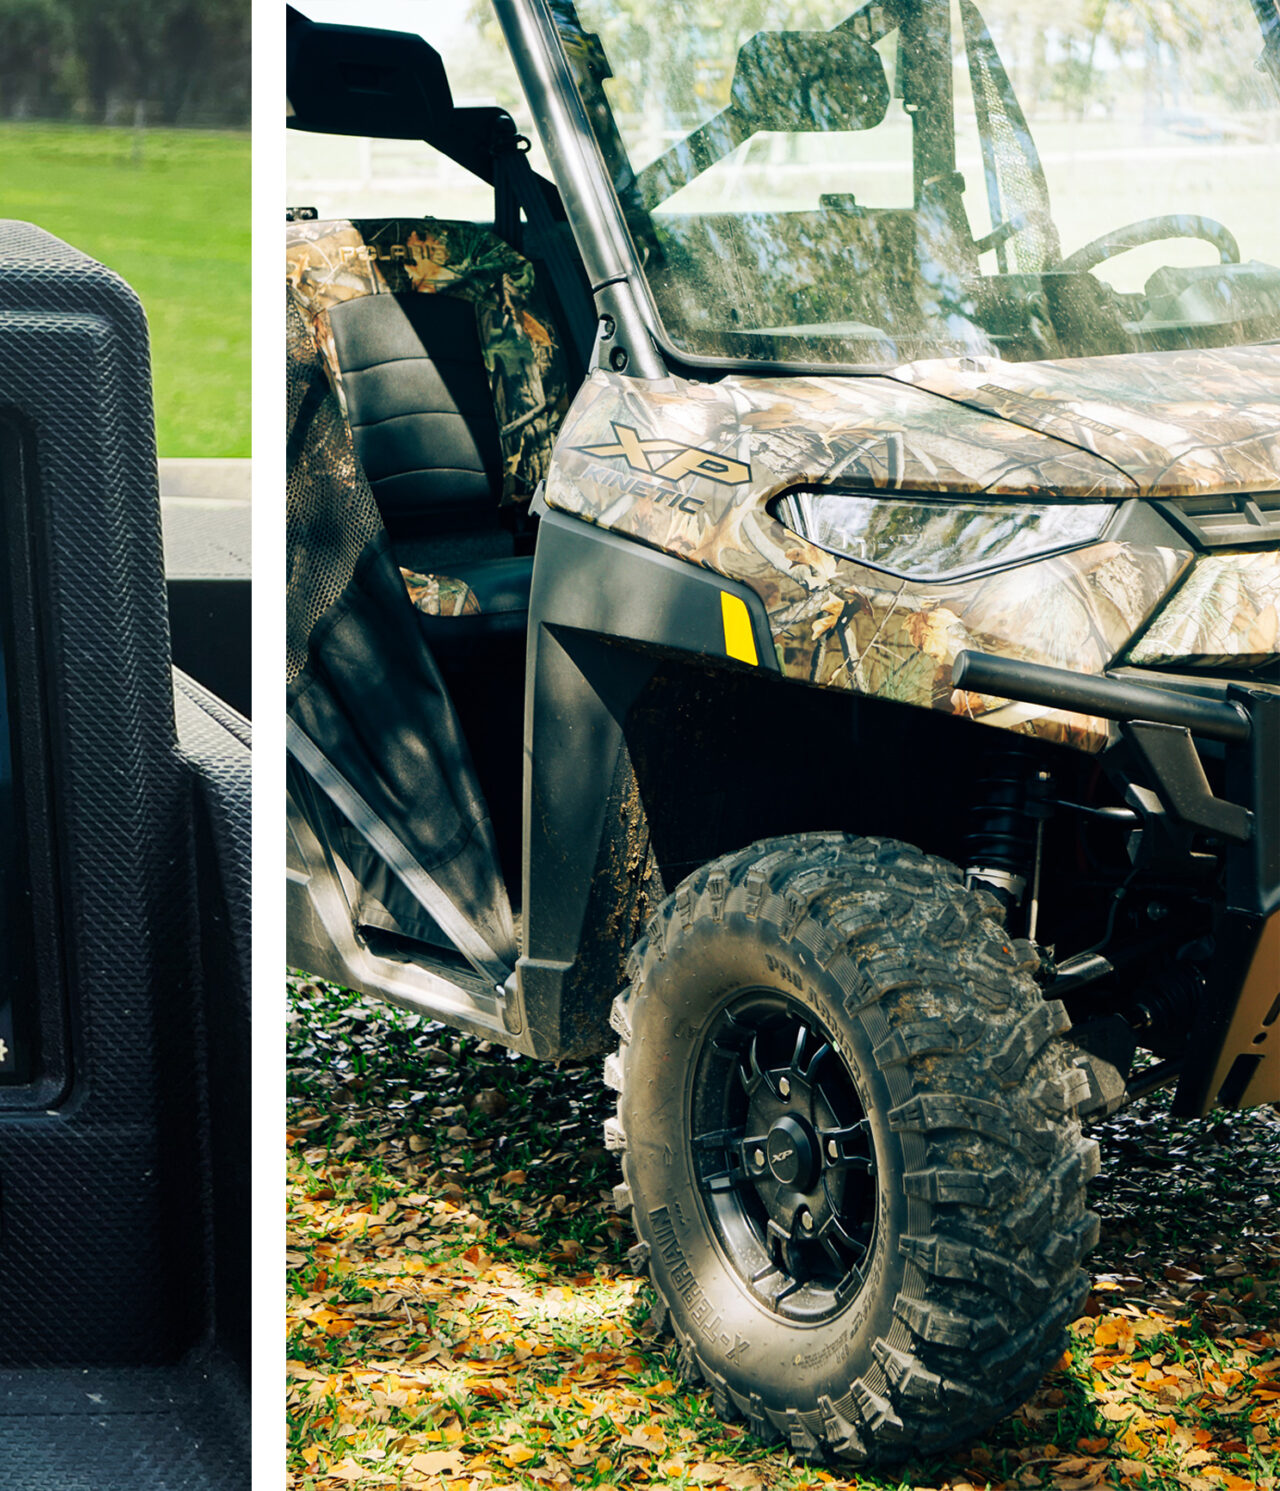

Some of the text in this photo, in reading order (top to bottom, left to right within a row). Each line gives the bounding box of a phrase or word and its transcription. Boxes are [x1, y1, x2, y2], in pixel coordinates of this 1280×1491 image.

[569, 420, 753, 486] XP
[581, 463, 706, 515] KINETIC
[771, 1149, 793, 1164] XP
[648, 1205, 751, 1367] X-TERRAIN
